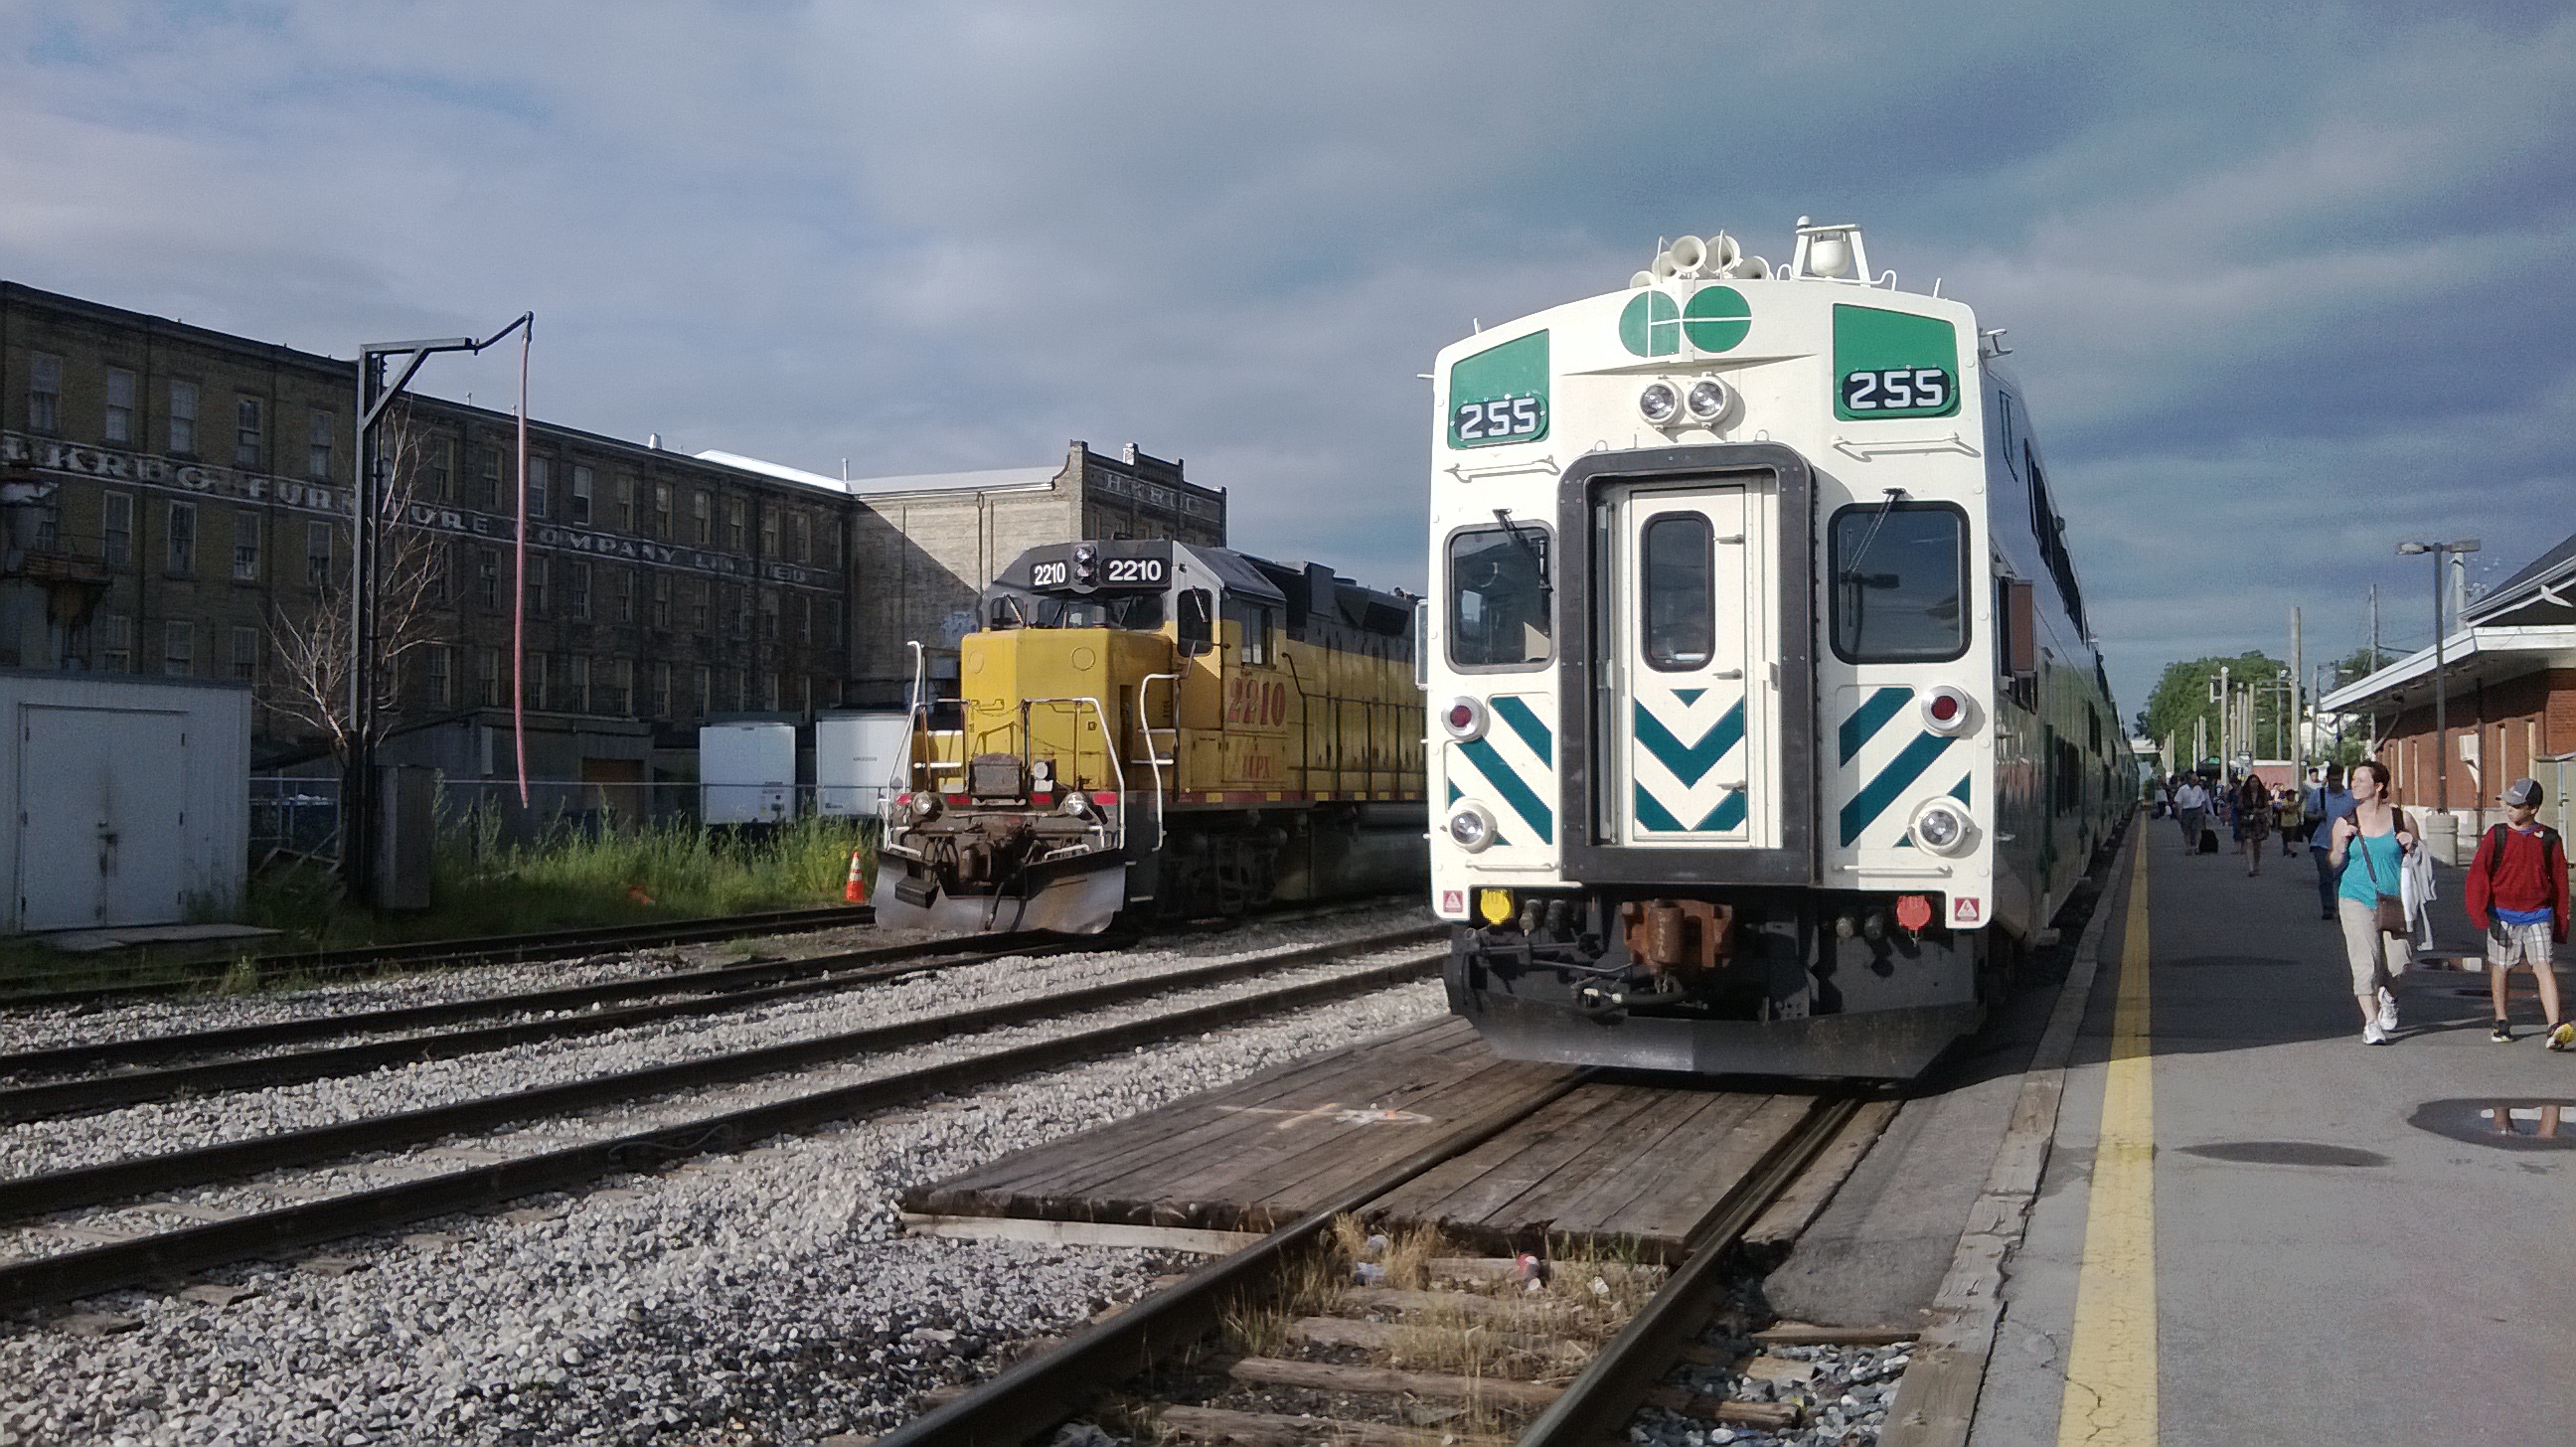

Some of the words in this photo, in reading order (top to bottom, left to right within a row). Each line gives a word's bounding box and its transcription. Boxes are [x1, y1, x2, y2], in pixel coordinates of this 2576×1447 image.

[1850, 369, 1943, 409] 255
[1460, 398, 1536, 440] 255
[248, 478, 489, 535] FURURE
[1034, 562, 1066, 586] 2210
[1108, 560, 1162, 581] 2210
[1226, 677, 1285, 726] 2210
